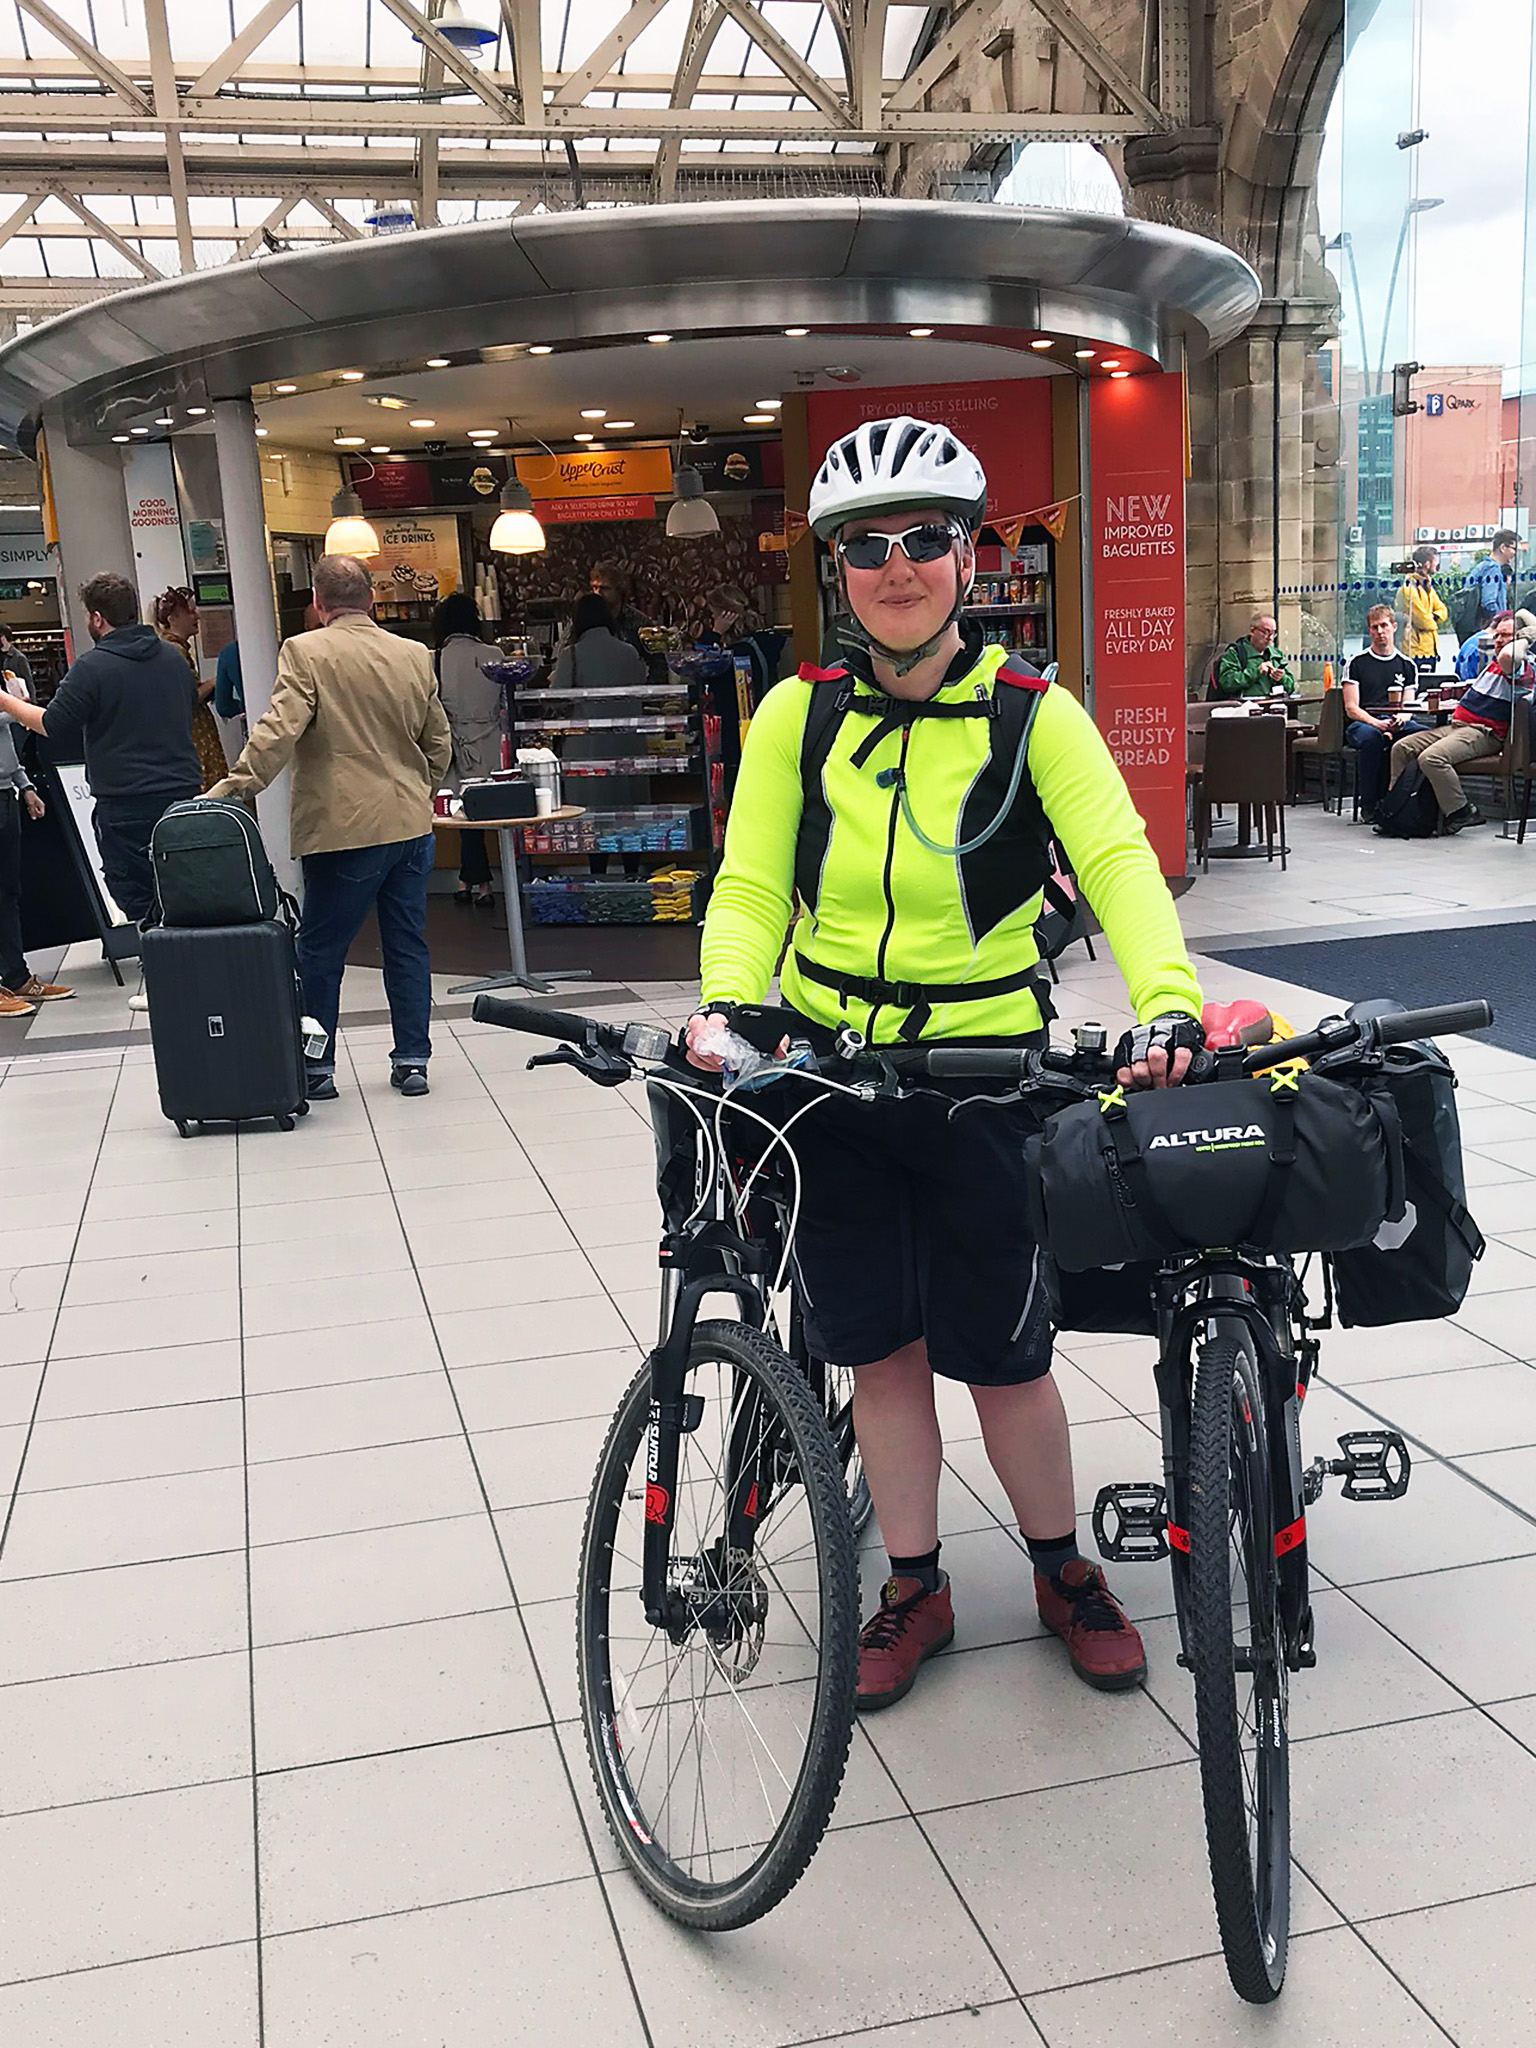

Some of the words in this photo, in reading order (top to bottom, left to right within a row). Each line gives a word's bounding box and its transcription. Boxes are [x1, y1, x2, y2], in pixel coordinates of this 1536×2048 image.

[860, 404, 882, 417] TRY
[885, 402, 914, 415] OUR
[917, 400, 944, 413] BEST
[948, 397, 999, 411] SELLING
[139, 498, 167, 508] GOOD
[570, 502, 597, 510] SELECTED
[598, 501, 615, 509] DRINK
[1106, 494, 1171, 523] NEW
[133, 508, 176, 518] MORNING
[557, 511, 586, 519] BAGUETTE
[131, 517, 179, 527] GOODNESS
[383, 534, 398, 545] ICE
[402, 532, 435, 543] DRINKS
[1105, 523, 1174, 540] IMPROVED
[1, 550, 49, 562] SIMPLY
[1103, 541, 1176, 558] BAGUETTES
[1105, 608, 1143, 620] FRESHLY
[1145, 606, 1176, 618] BAKED
[1105, 621, 1136, 639] ALL
[1141, 618, 1175, 637] DAY
[1105, 640, 1146, 655] EVERY
[1149, 638, 1175, 653] DAY
[1114, 707, 1167, 725] FRESH
[1107, 727, 1176, 746] CRUSTY
[1114, 748, 1170, 767] BREAD
[1149, 1124, 1266, 1150] ALTURA
[648, 1422, 660, 1482] SUNTOUR
[1272, 1697, 1281, 1748] SHIMANO
